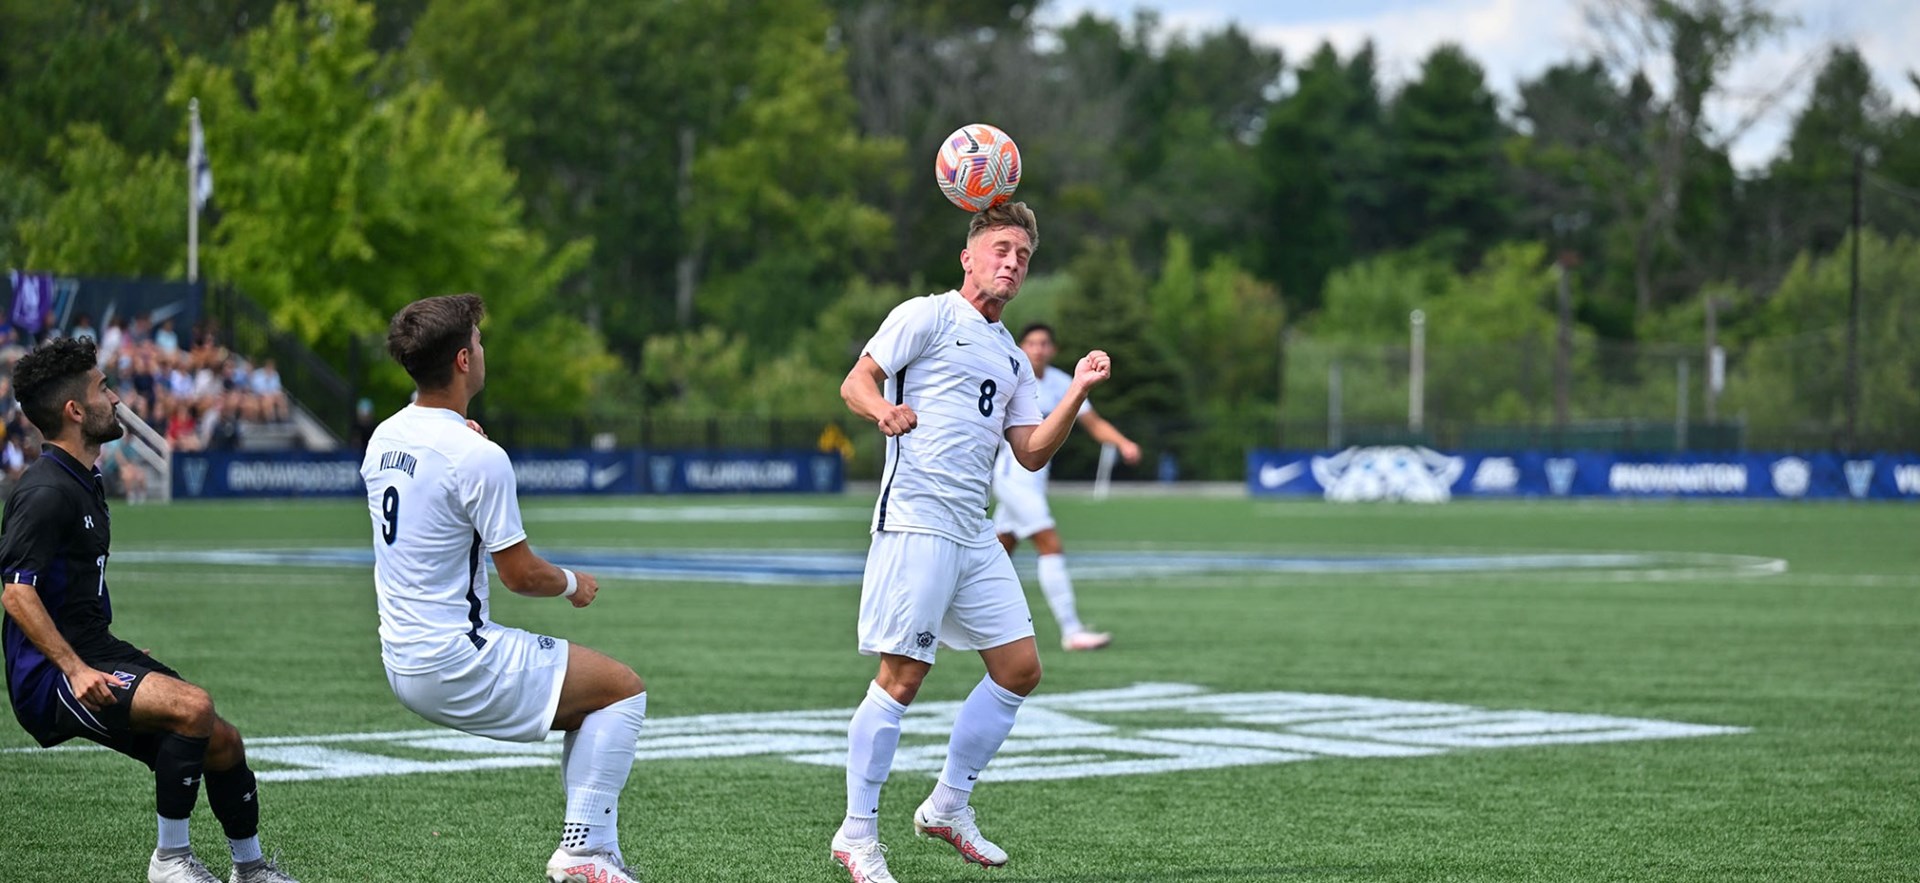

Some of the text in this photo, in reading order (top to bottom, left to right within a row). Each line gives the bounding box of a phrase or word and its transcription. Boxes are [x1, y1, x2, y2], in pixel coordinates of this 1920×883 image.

[978, 378, 997, 418] 8
[379, 450, 417, 479] VILLANOVA
[382, 487, 399, 546] 9
